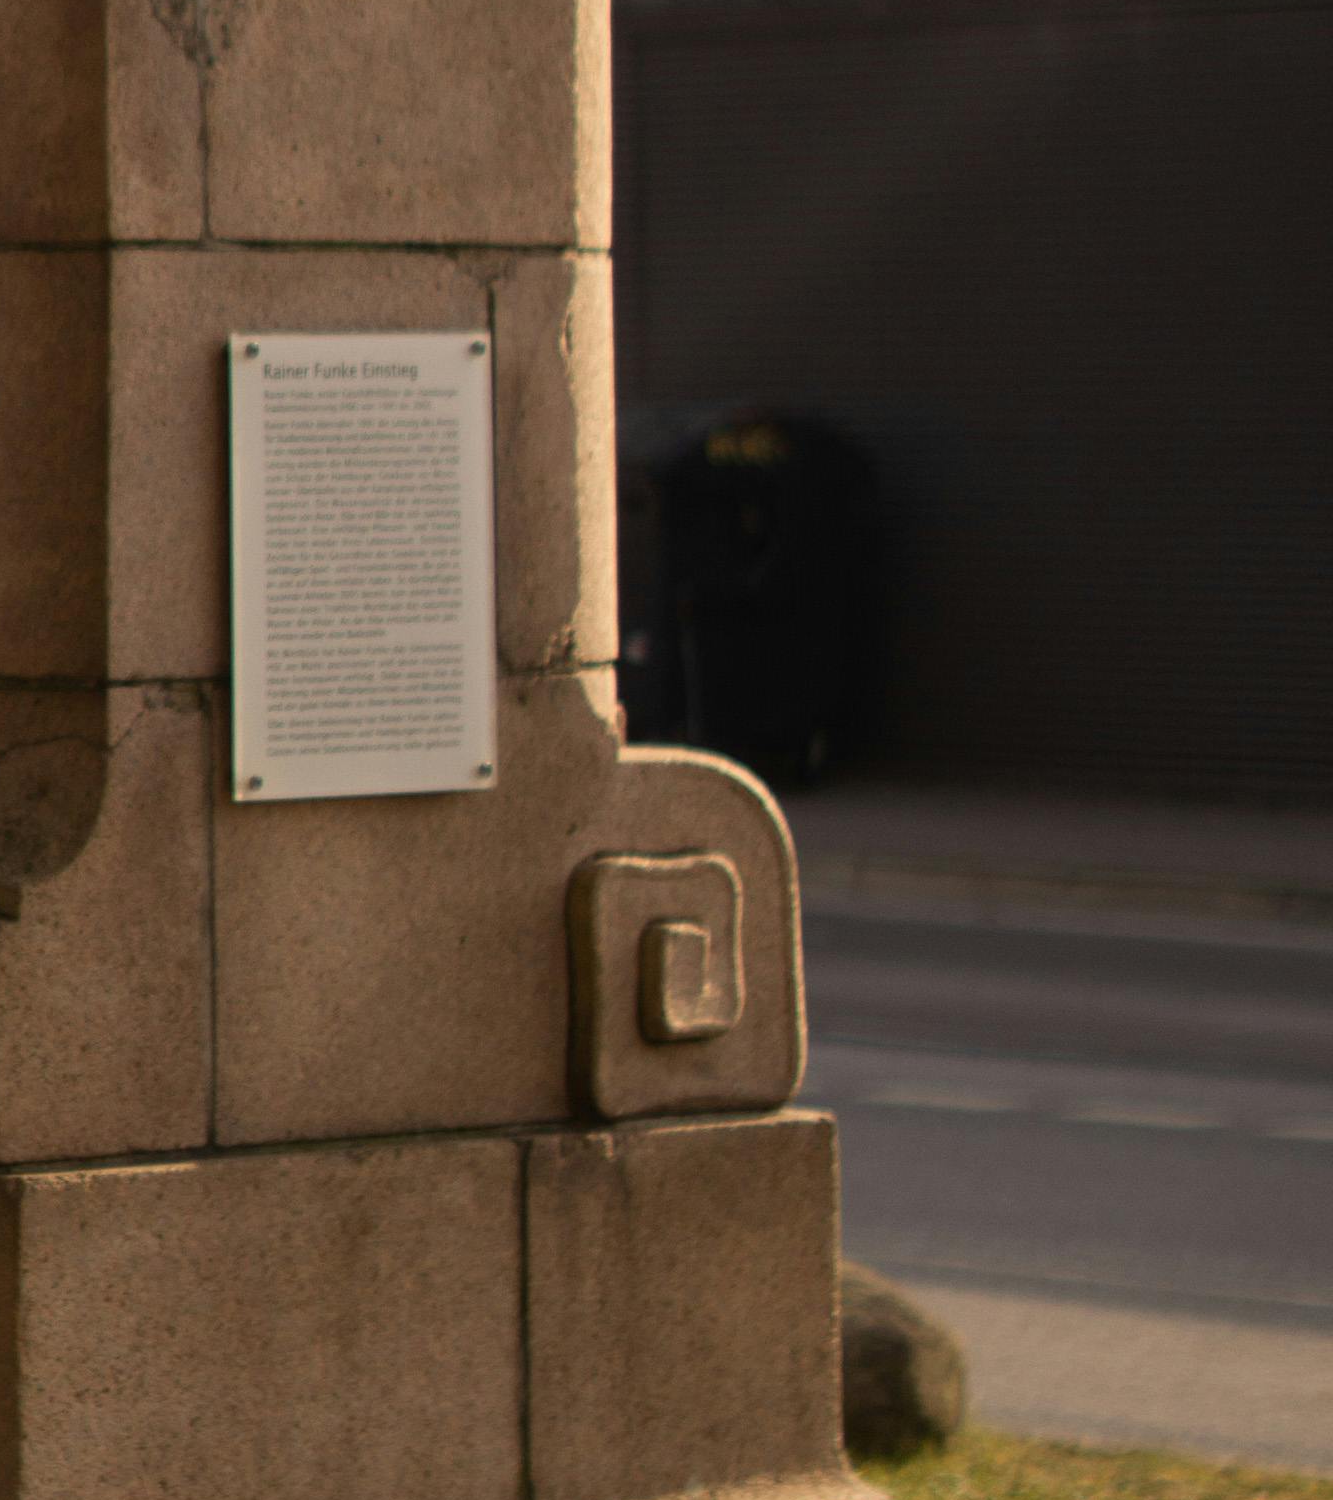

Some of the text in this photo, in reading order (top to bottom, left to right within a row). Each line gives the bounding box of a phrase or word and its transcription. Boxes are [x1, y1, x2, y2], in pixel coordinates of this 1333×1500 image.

[263, 362, 418, 381] Rainer Funke Einstieg
